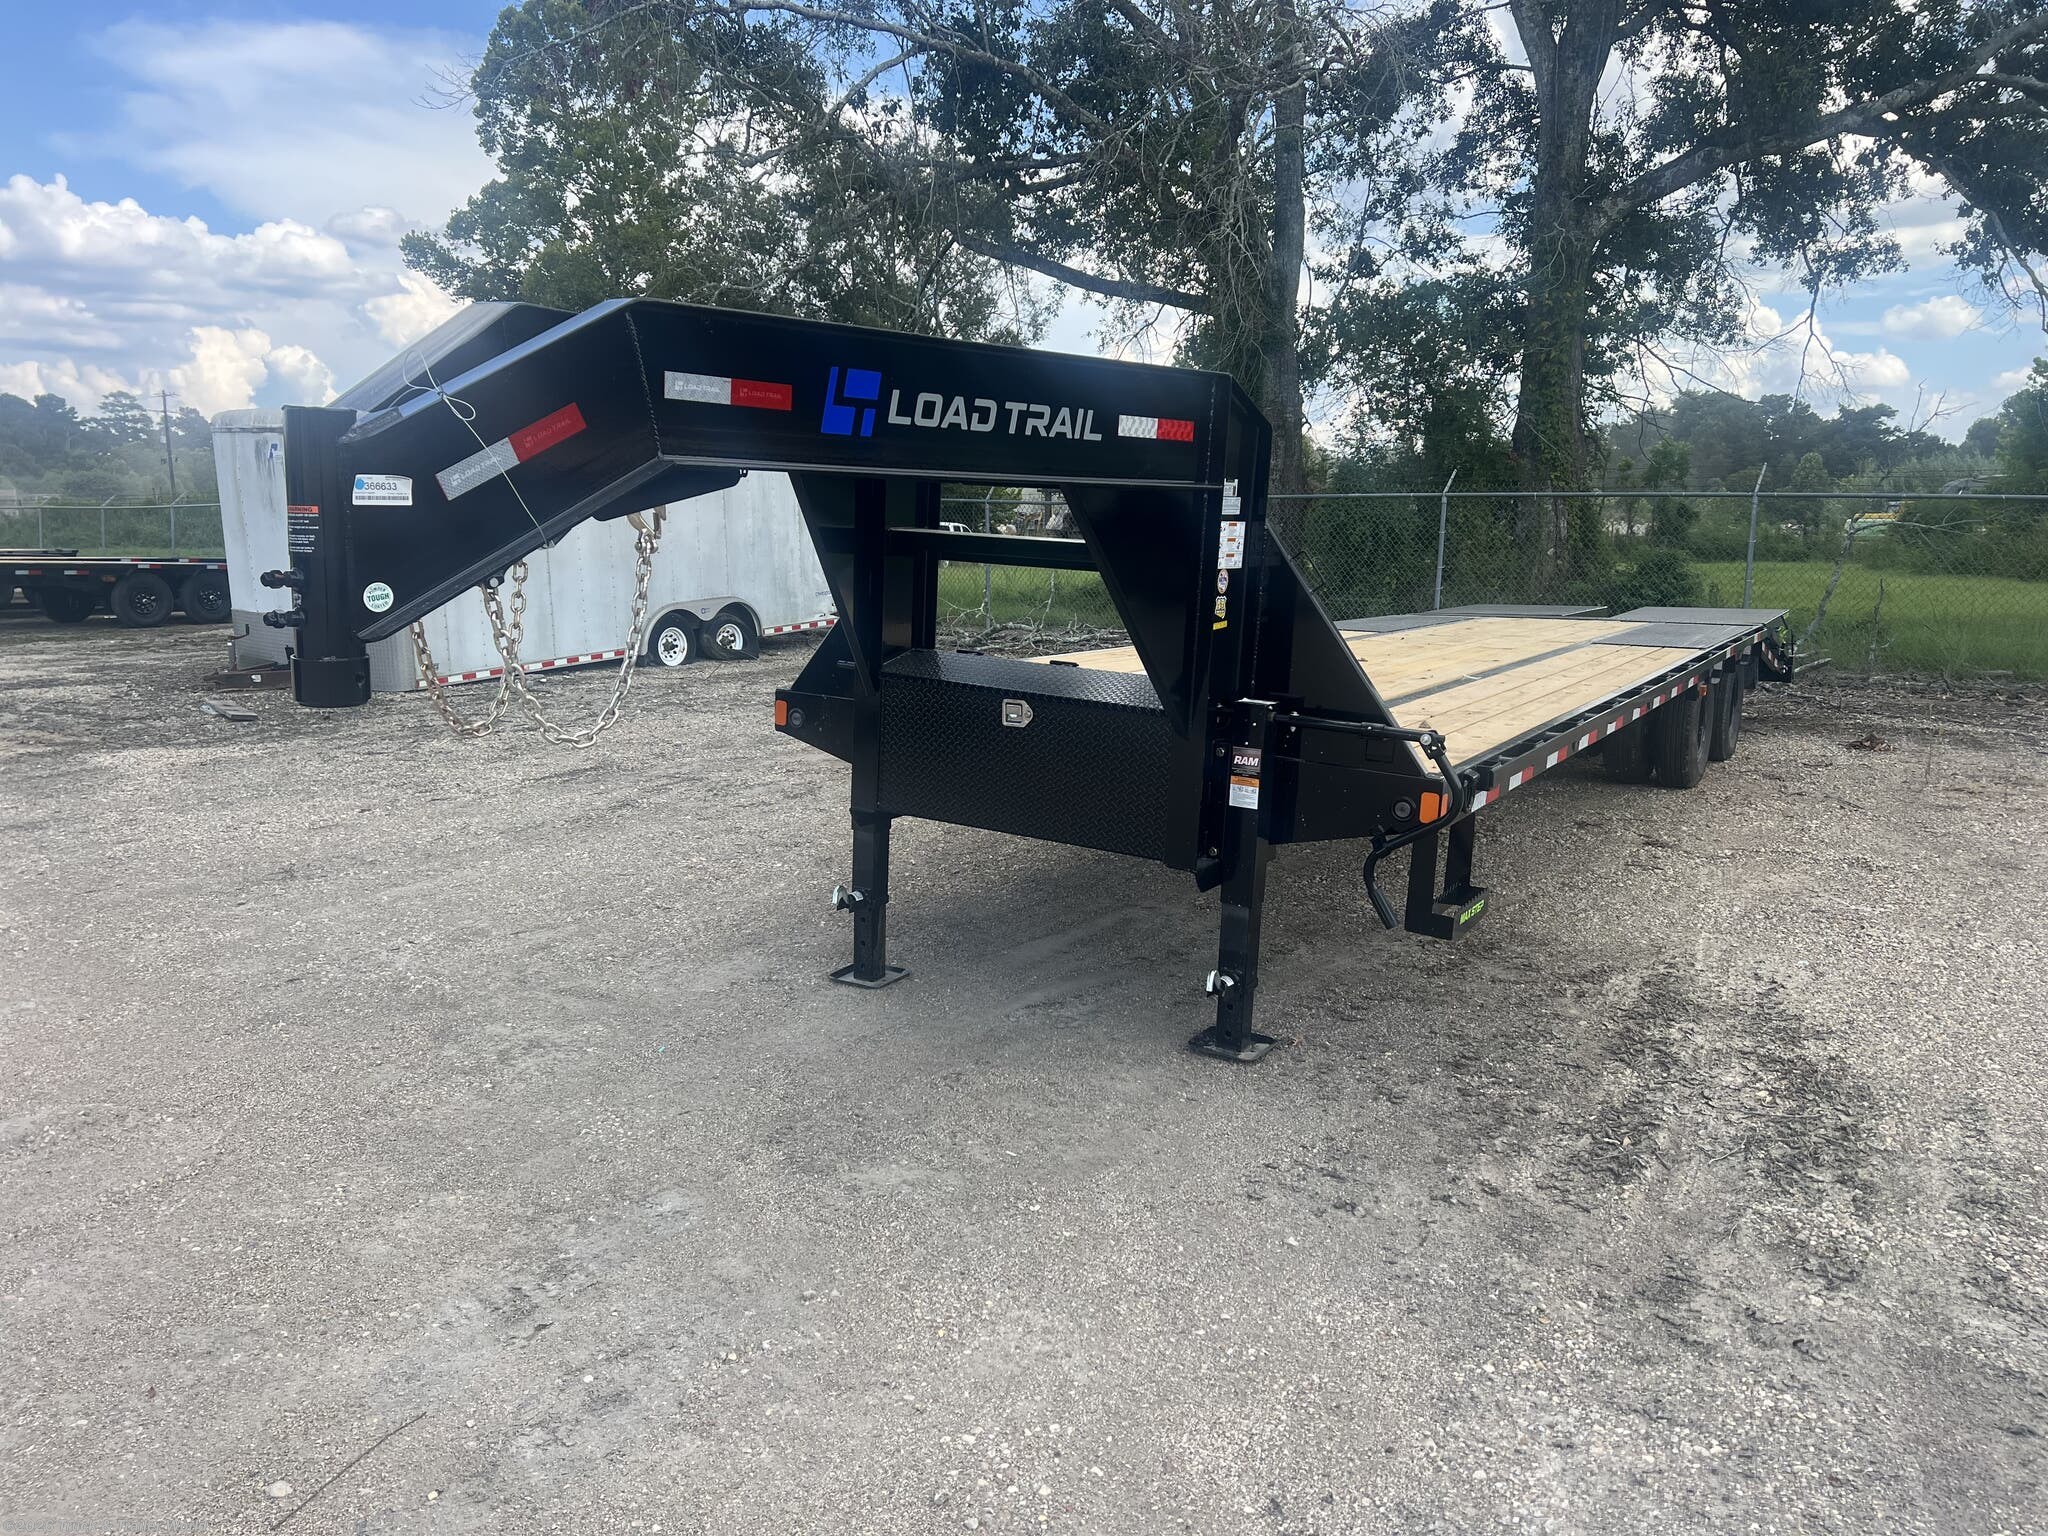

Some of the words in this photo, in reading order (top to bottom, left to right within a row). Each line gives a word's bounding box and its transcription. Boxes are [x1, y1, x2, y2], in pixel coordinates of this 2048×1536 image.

[887, 389, 998, 432] LOAD
[1004, 401, 1102, 441] TRAIL
[367, 592, 390, 602] TOUGH
[1233, 755, 1259, 767] RAM
